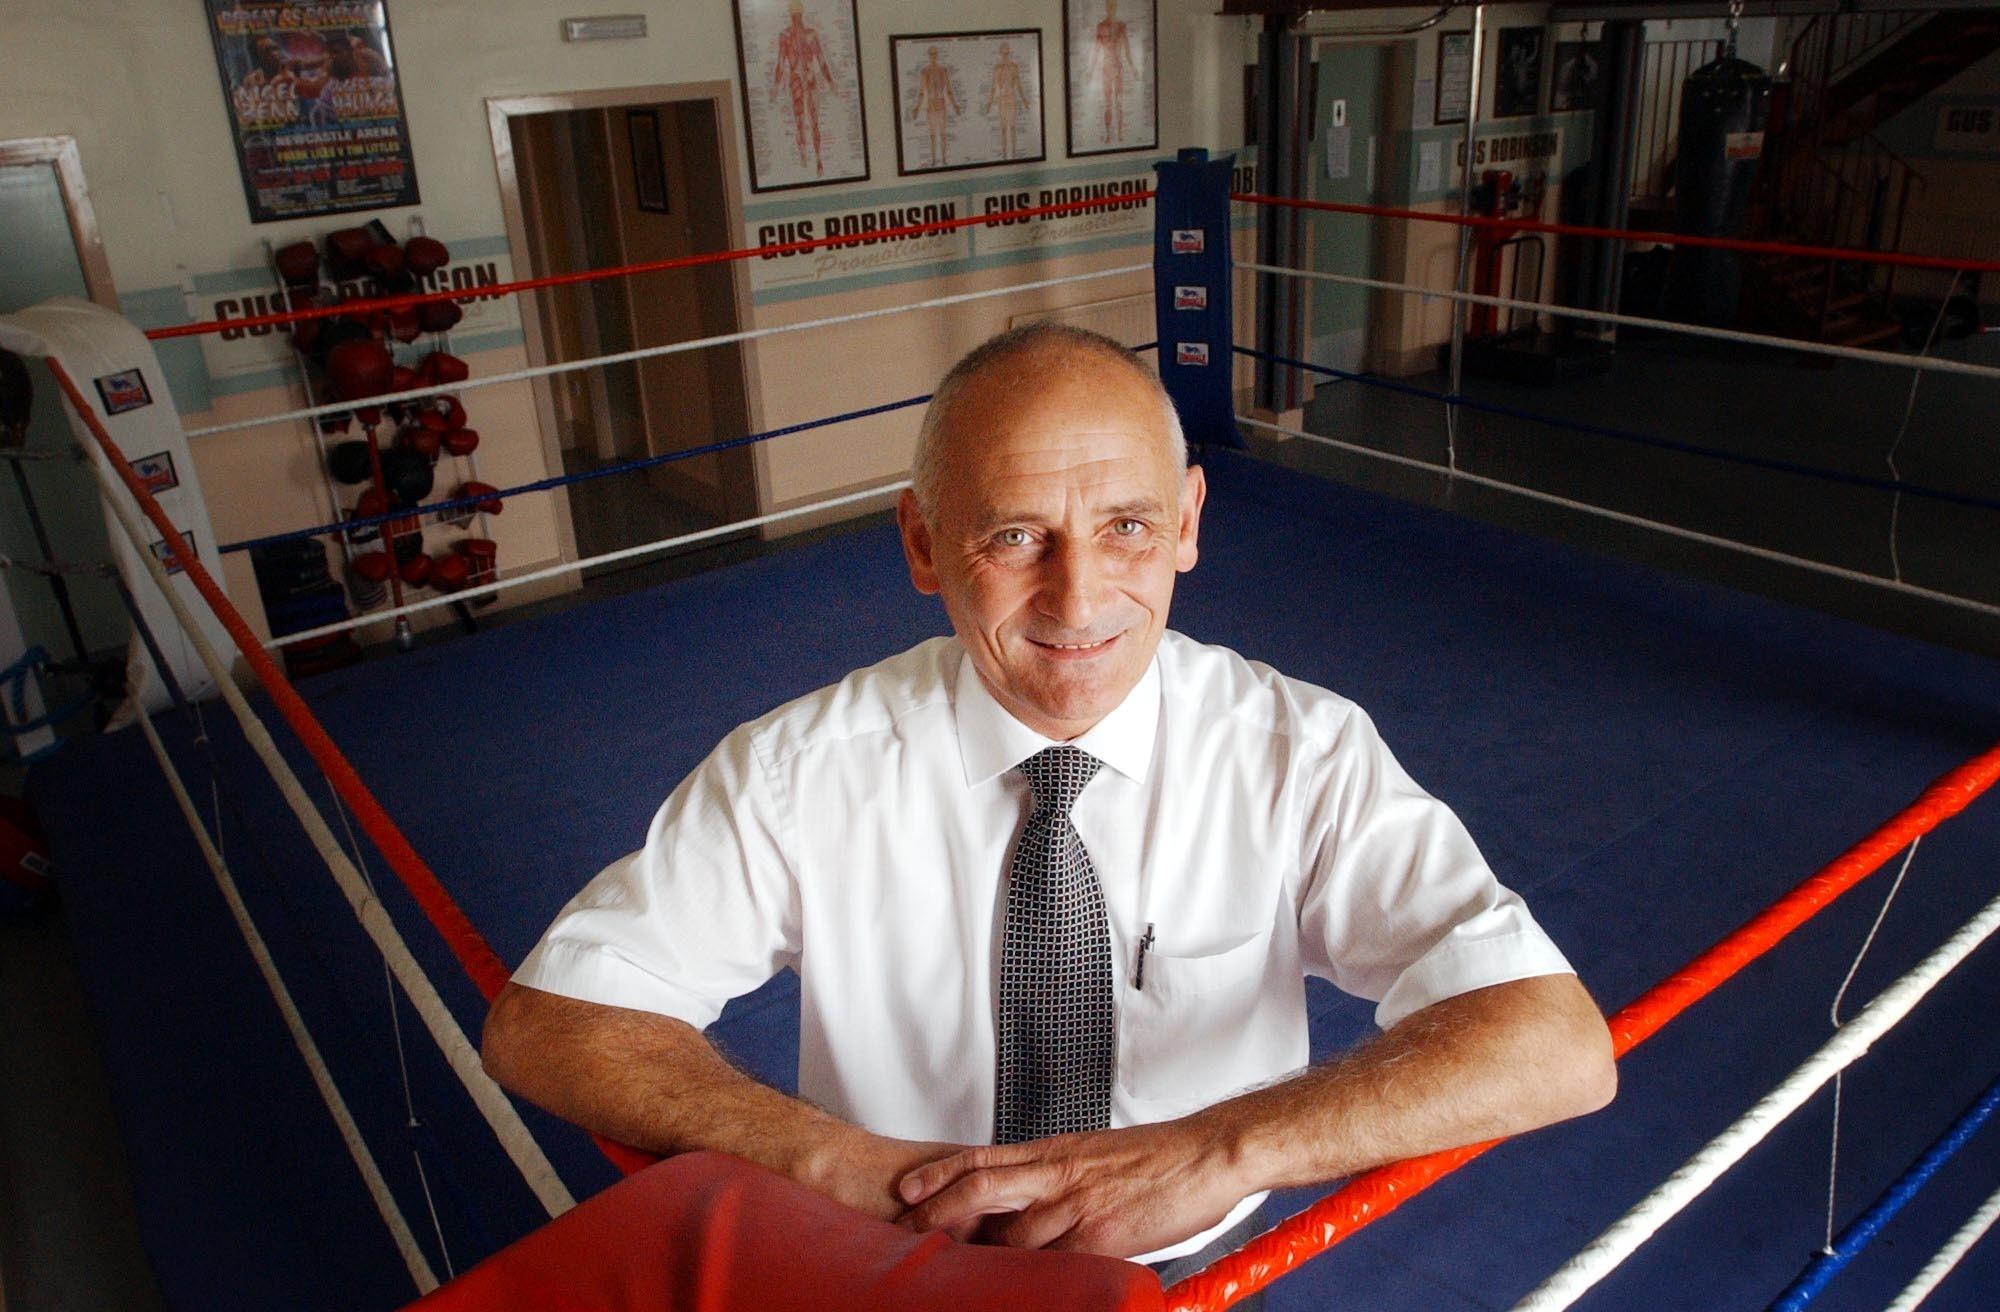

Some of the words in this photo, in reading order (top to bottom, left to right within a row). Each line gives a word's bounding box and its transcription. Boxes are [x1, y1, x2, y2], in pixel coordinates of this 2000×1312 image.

[274, 129, 352, 146] NEWCASTLE
[356, 126, 399, 139] ARENA
[984, 192, 1030, 228] GUS
[1040, 178, 1148, 221] ROBINSON
[758, 219, 813, 260] GUS
[825, 202, 956, 250] ROBINSON
